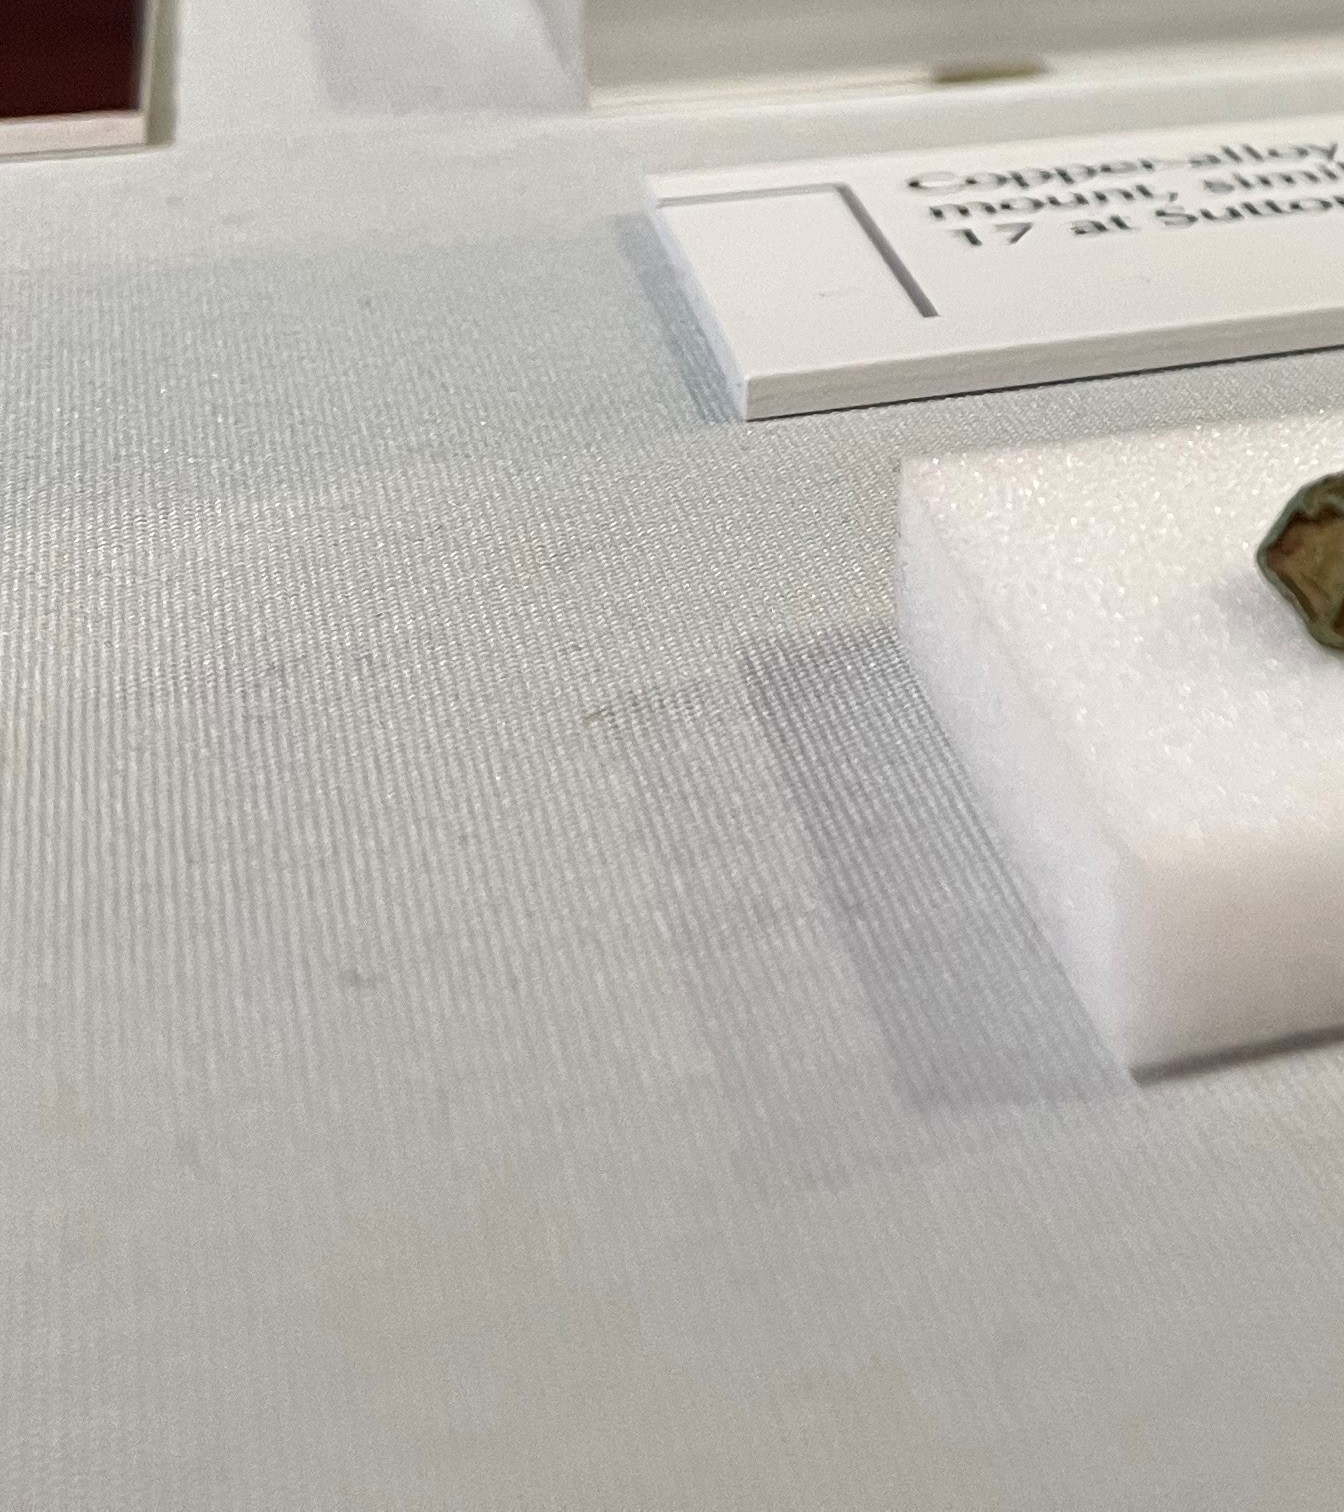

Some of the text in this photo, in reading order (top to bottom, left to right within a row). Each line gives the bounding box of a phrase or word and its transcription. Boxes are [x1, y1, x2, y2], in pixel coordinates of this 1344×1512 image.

[906, 141, 1339, 195] Copper-alloy
[928, 184, 1179, 222] mount,
[955, 221, 1034, 248] 17
[1071, 213, 1136, 237] at
